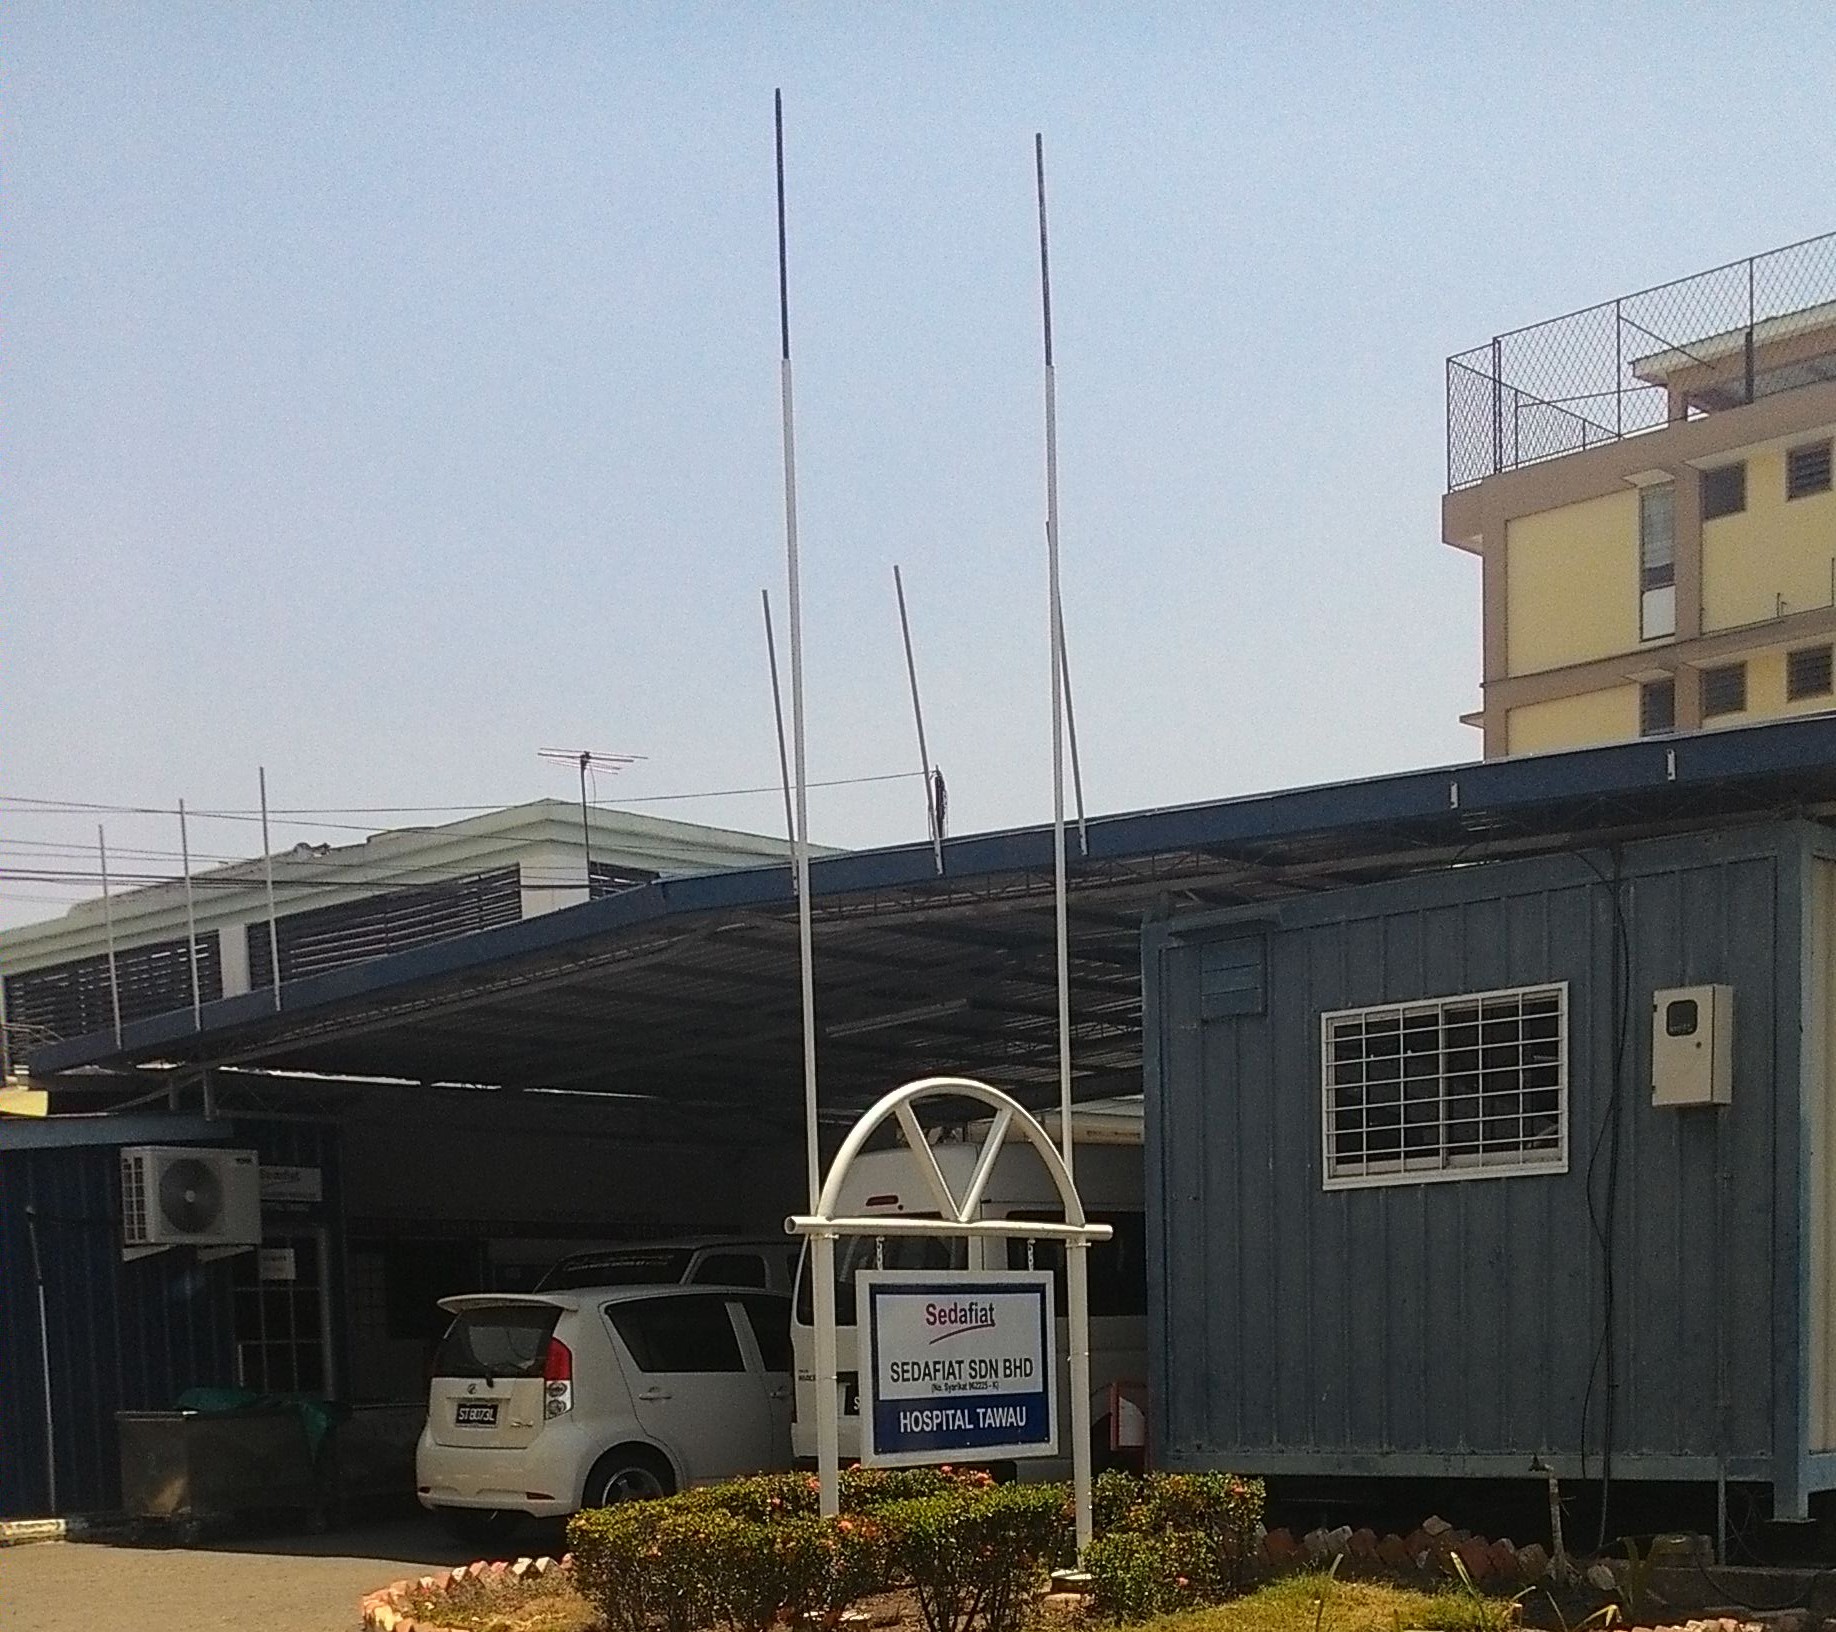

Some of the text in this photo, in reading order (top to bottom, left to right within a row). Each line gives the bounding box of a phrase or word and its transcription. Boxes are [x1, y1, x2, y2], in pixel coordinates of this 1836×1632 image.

[925, 1302, 995, 1326] Sedafiat
[890, 1357, 1033, 1382] SEDAFIAT SDN BHD
[900, 1406, 1027, 1433] HOSPITAL TAWAU
